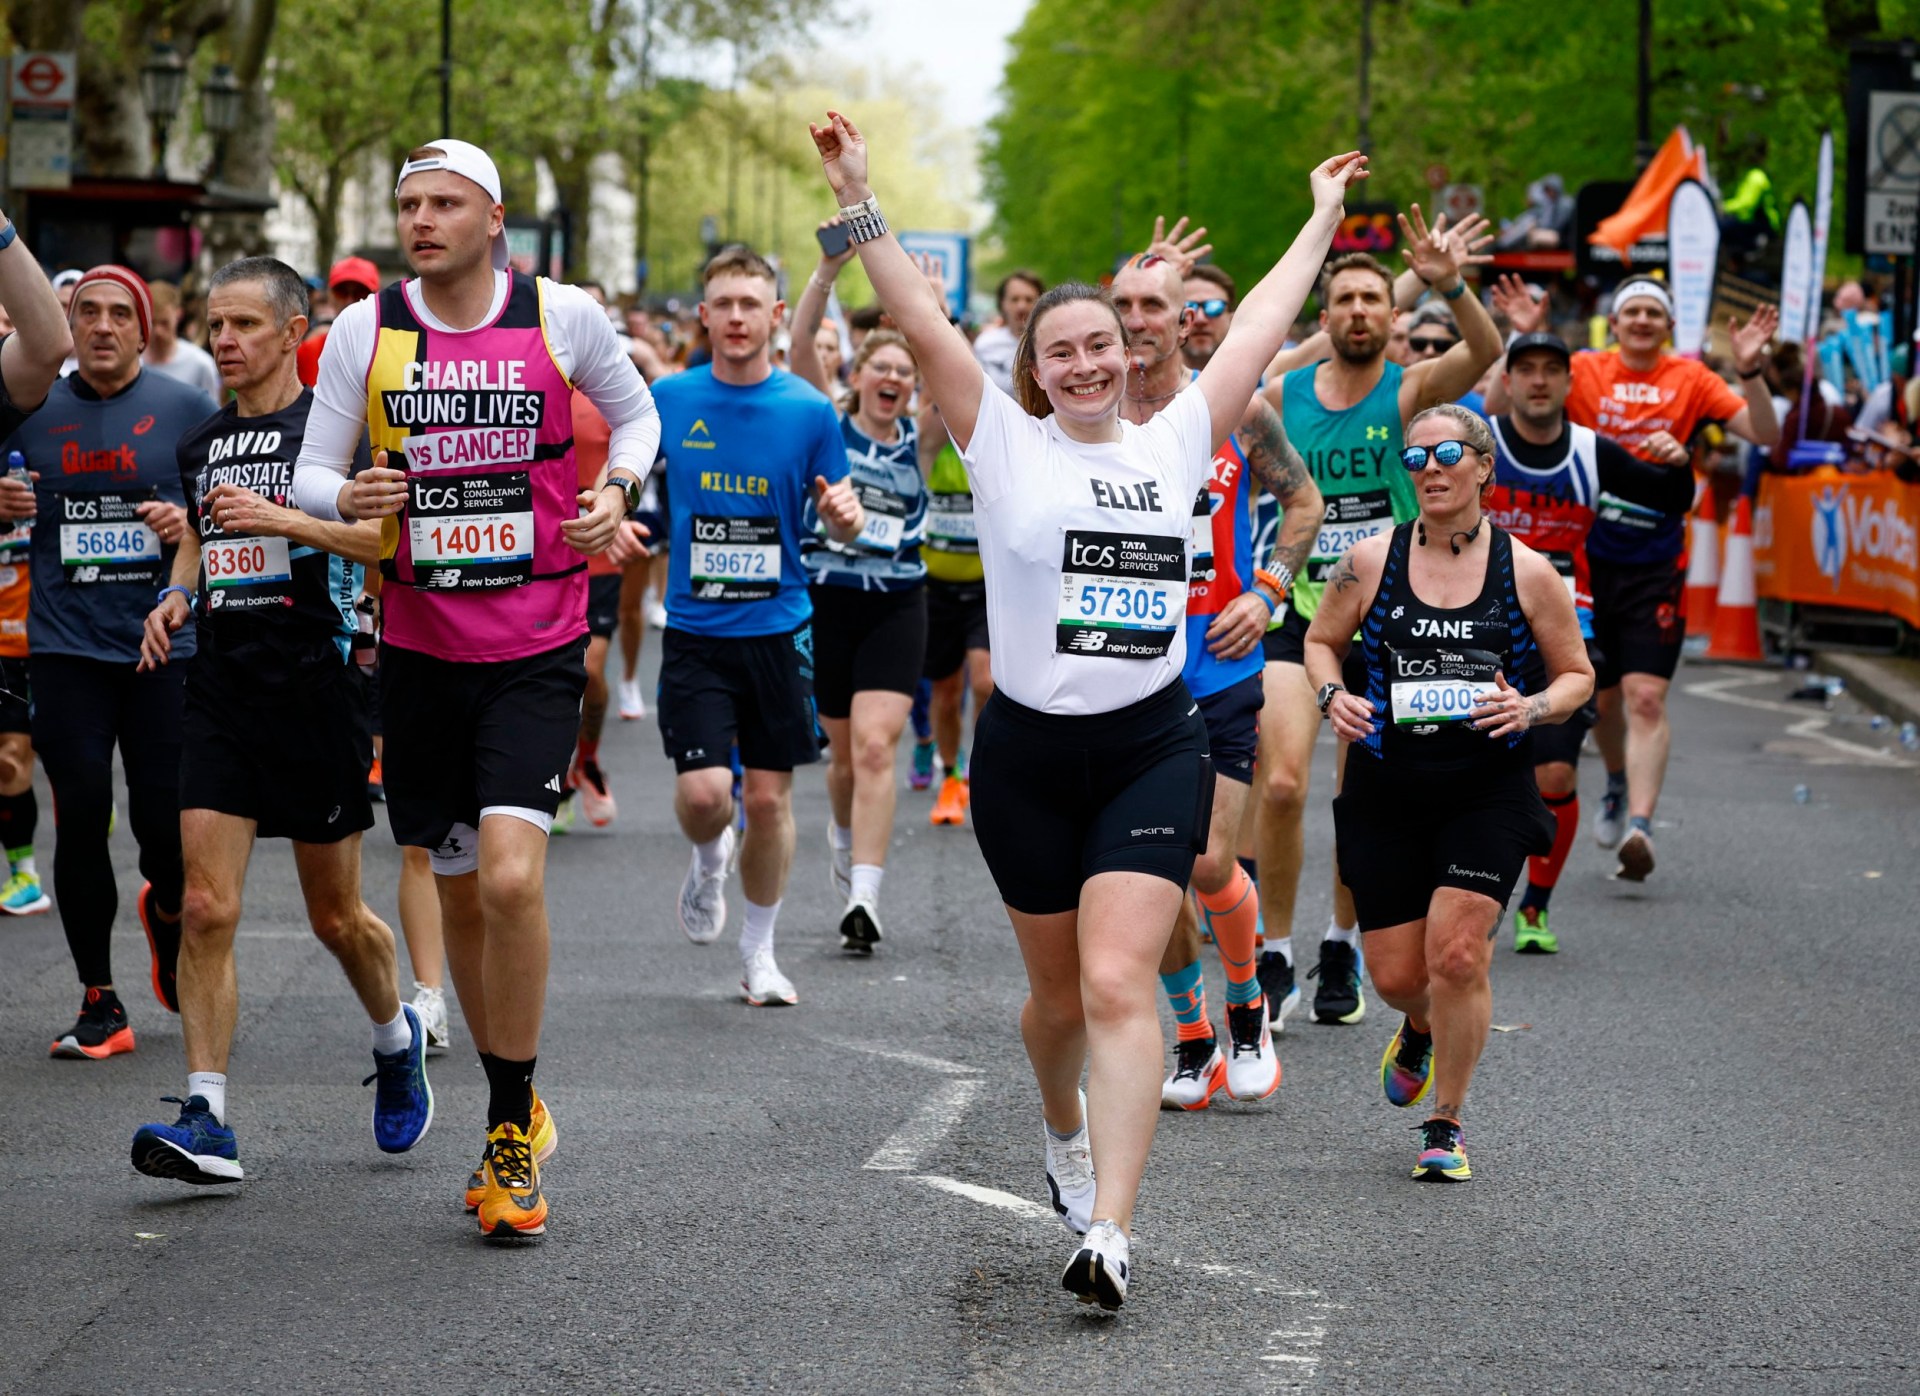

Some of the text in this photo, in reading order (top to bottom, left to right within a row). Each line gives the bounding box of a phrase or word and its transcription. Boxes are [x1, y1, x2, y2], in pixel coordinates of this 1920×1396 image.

[403, 360, 526, 392] CHARLIE
[387, 393, 540, 425] YOUNG LIVES
[62, 441, 138, 475] Quark
[208, 431, 282, 465] DAVID
[437, 429, 530, 464] CANCER
[210, 462, 291, 492] PROSTATE
[701, 471, 769, 496] MILLER
[1211, 456, 1238, 488] KE
[463, 480, 489, 488] TATA
[463, 487, 525, 499] CONSULTANCY
[1090, 478, 1163, 512] ELLIE
[64, 496, 98, 519] tcs
[100, 495, 121, 503] TATA
[100, 502, 140, 511] CONSULTAN
[415, 483, 459, 510] tcs
[463, 498, 504, 508] SERVICES
[431, 523, 516, 555] 14016
[696, 518, 727, 541] tcs
[77, 531, 145, 555] 56846
[1071, 538, 1115, 568] tcs
[1121, 541, 1147, 551] TATA
[704, 552, 766, 574] 59672
[1119, 561, 1159, 572] SERVICES
[1120, 551, 1179, 563] CONSULTANCY
[462, 575, 523, 587] new balance
[226, 595, 284, 607] new balance
[1080, 585, 1167, 620] 57305
[1411, 618, 1474, 639] JANE
[1107, 643, 1128, 653] new
[1397, 655, 1437, 677] tcs
